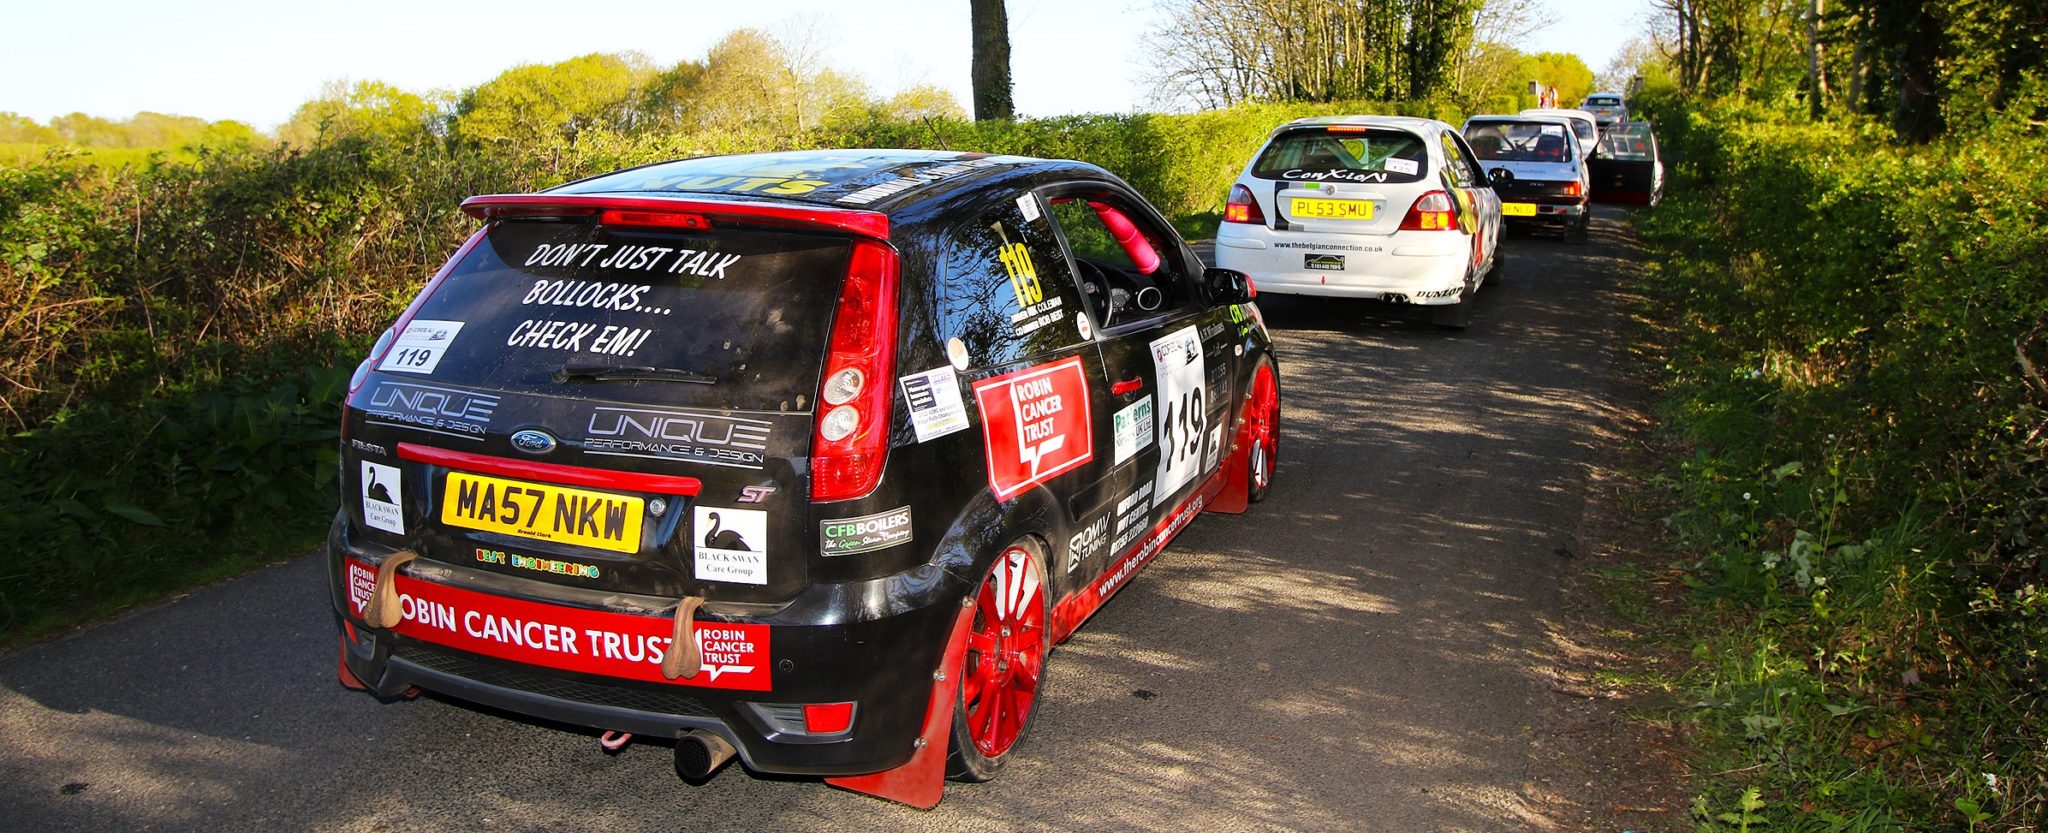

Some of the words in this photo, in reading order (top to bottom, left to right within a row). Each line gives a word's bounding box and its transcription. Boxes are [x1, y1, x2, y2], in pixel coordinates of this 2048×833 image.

[1297, 201, 1334, 215] PL53
[1339, 203, 1367, 216] SMU
[525, 243, 608, 267] DON'T
[600, 245, 673, 271] JUST
[668, 249, 742, 279] TALK
[999, 242, 1043, 308] 119
[1415, 286, 1464, 298] DUNLOP
[507, 319, 597, 352] CHECK
[589, 325, 652, 357] EM!
[396, 348, 432, 367] 119
[1016, 377, 1053, 402] ROBIN
[370, 387, 498, 422] UNIQUE
[1021, 395, 1063, 423] CANCER
[365, 408, 436, 426] PERFORMANCE
[447, 421, 487, 435] DESIGN
[588, 412, 771, 450] UNIQUE
[1023, 417, 1055, 443] TRUST
[1163, 386, 1204, 473] 119
[351, 439, 387, 457] FIESTA
[518, 434, 544, 448] Ford
[584, 437, 690, 455] PERFORMANCE
[694, 447, 704, 456] &
[708, 448, 765, 464] DESIGN
[737, 485, 776, 503] ST
[365, 500, 383, 513] BLACK
[383, 506, 399, 516] SWAN
[456, 479, 545, 528] MA57
[553, 493, 628, 542] NKW
[381, 515, 397, 527] Group
[825, 539, 837, 550] The
[838, 539, 860, 550] Green
[879, 529, 910, 542] Company
[1081, 533, 1107, 561] TUNING
[1098, 494, 1203, 597] www.therobincancertrust.org
[475, 548, 506, 565] BEST
[511, 553, 600, 578] ENGINEERING
[698, 551, 730, 563] BLACK
[732, 553, 760, 564] SWAN
[353, 565, 375, 582] ROBIN
[706, 564, 726, 574] Care
[727, 565, 754, 577] Group
[353, 576, 376, 593] CANCE
[399, 593, 457, 633] OBIN
[464, 610, 580, 655] CANCER
[704, 628, 746, 641] ROBIN
[704, 640, 755, 653] CANCER
[704, 652, 741, 665] TRUST
